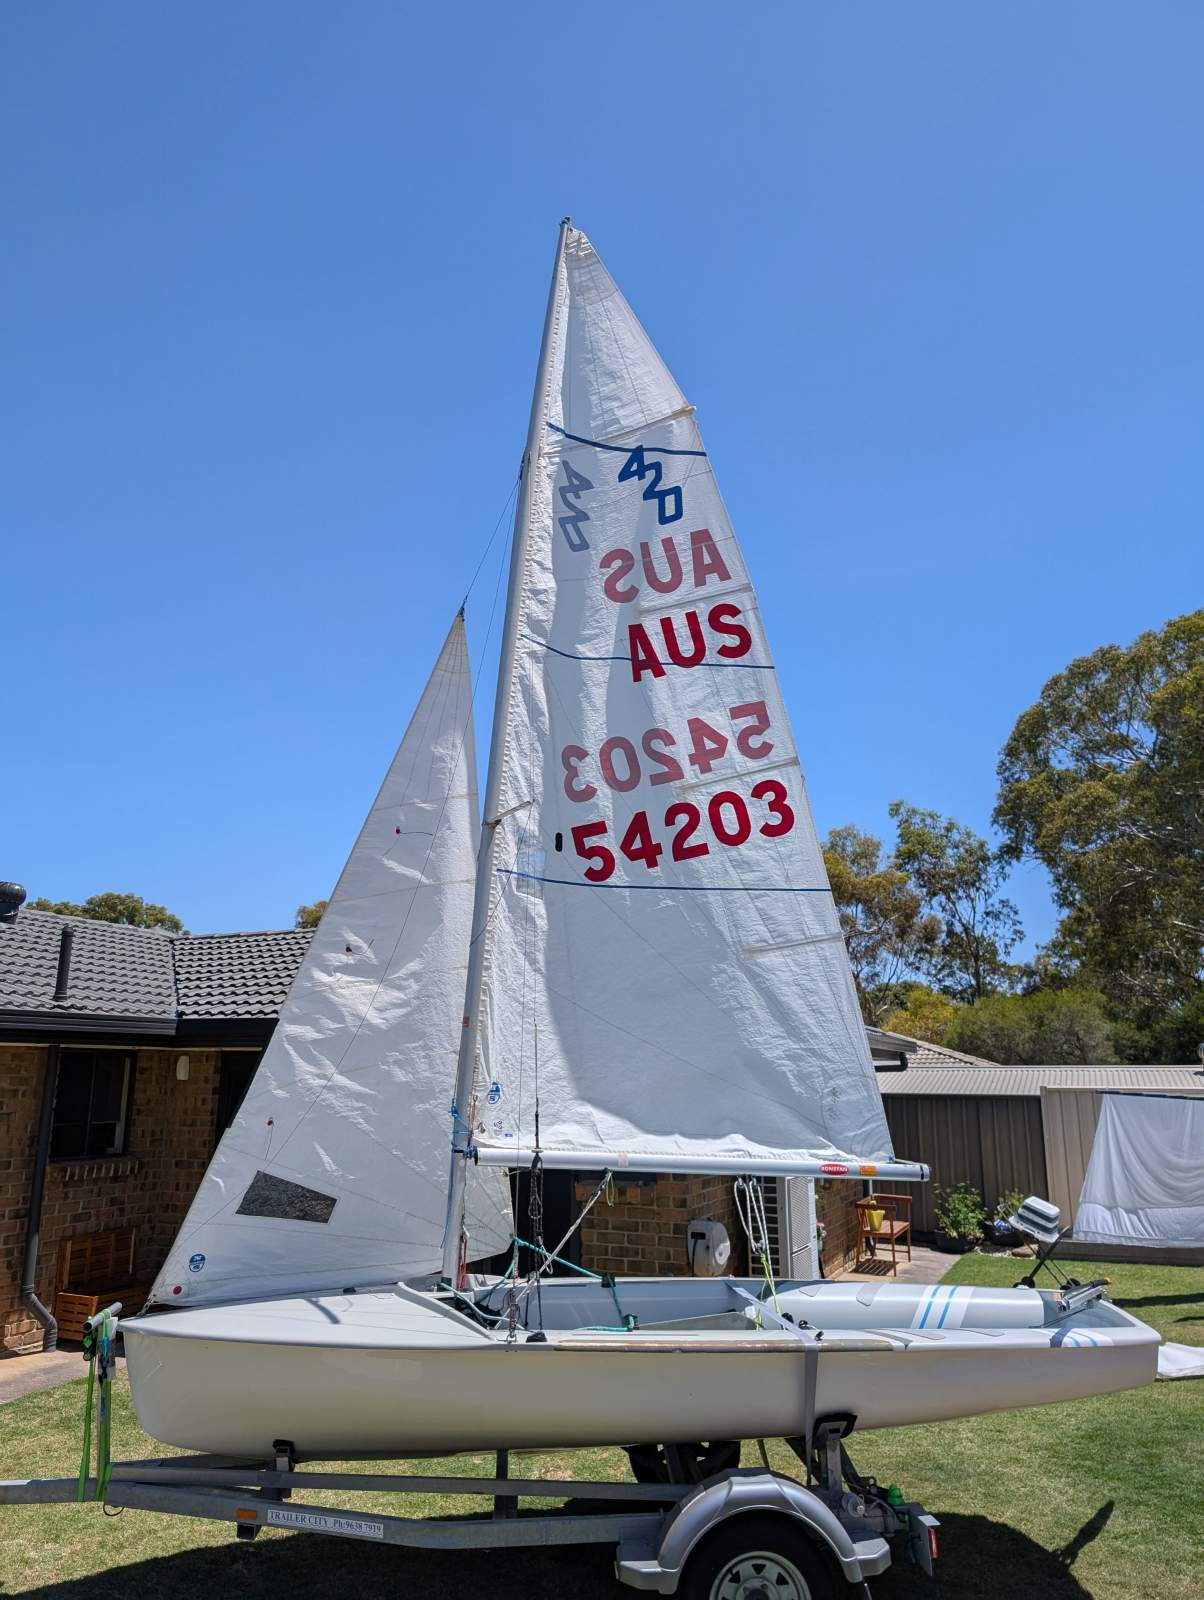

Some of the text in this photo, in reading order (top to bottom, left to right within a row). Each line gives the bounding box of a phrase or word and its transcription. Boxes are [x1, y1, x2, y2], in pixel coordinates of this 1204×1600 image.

[618, 445, 683, 525] 420
[628, 603, 752, 683] AUS
[571, 779, 795, 883] 54203
[270, 1510, 306, 1524] TRAILER
[308, 1514, 329, 1527] CITY
